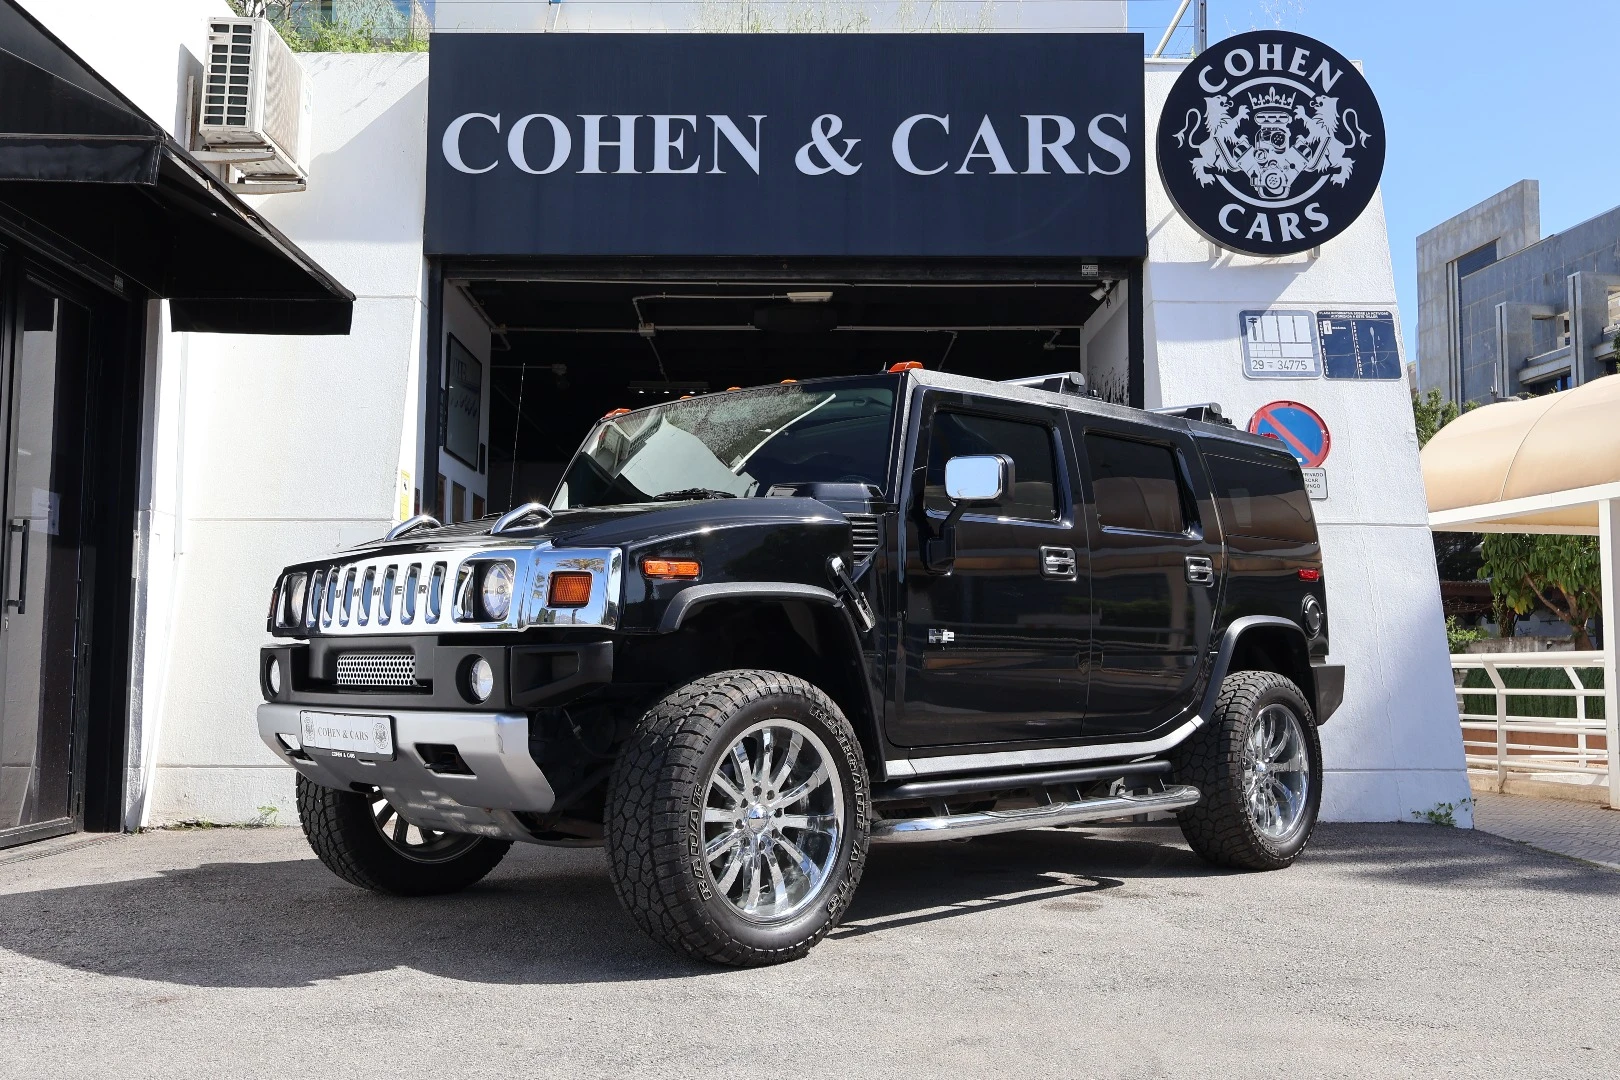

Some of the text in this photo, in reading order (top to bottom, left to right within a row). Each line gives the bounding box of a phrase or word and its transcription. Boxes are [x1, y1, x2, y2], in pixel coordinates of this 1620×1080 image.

[1197, 43, 1344, 94] COHEN
[441, 113, 1131, 176] COHEN & CARS
[1218, 202, 1329, 243] CARS
[1252, 359, 1265, 370] 29
[1277, 359, 1308, 371] 34775
[317, 727, 341, 738] COHEN
[343, 729, 349, 739] &
[350, 729, 369, 741] CARS
[809, 704, 865, 831] RENEGADE
[689, 783, 713, 901] RADAR
